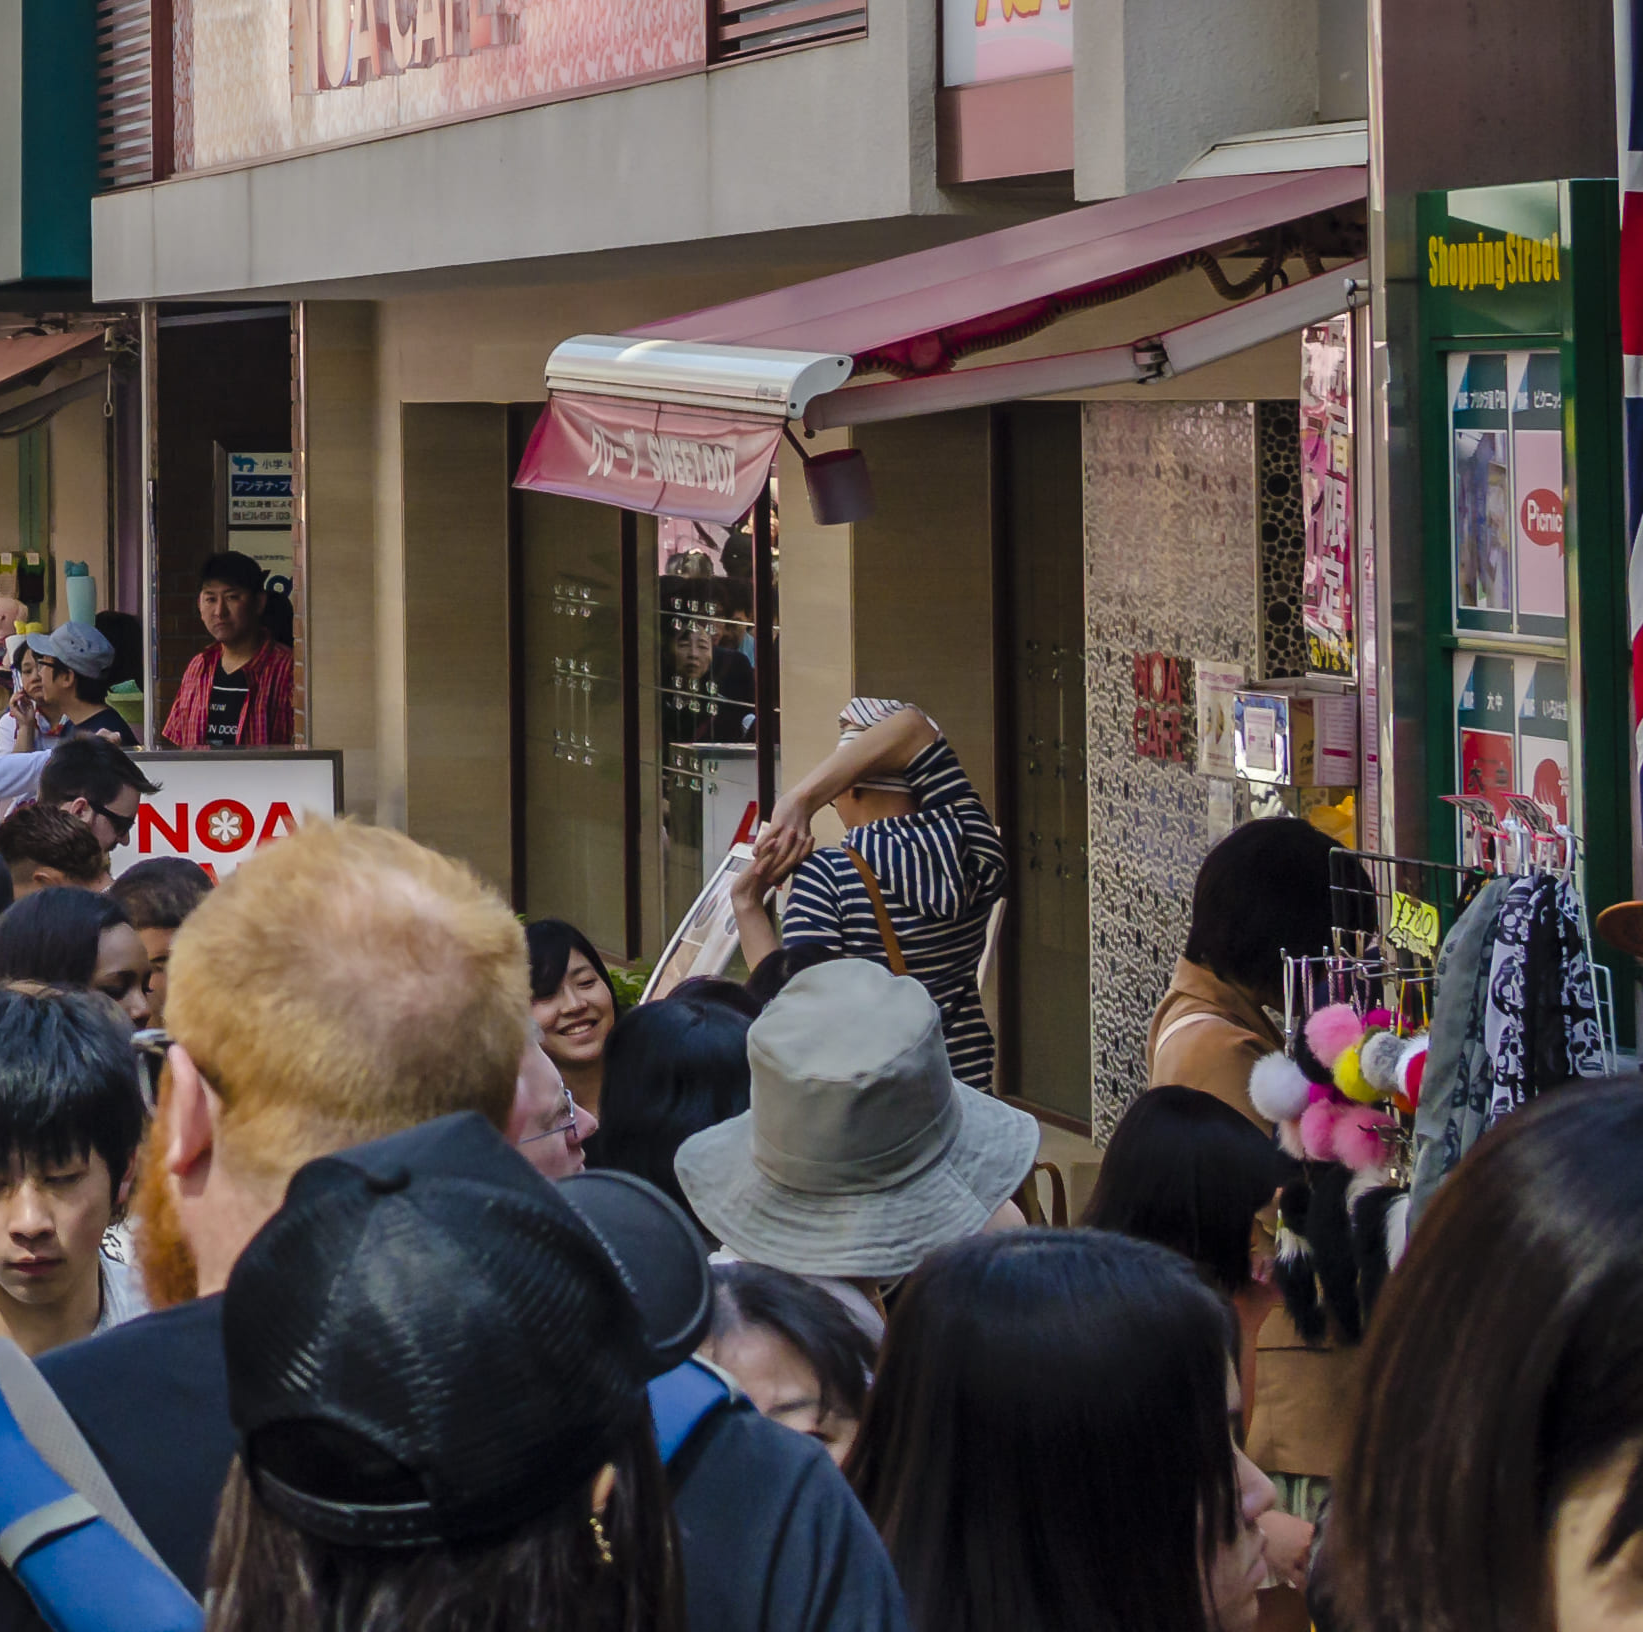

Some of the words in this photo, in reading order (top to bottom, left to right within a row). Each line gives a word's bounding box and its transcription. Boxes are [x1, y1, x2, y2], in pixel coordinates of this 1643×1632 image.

[1428, 231, 1505, 291] Shopping
[1506, 231, 1560, 285] Street
[646, 432, 702, 489] SWEET
[701, 443, 736, 497] BOX
[1527, 499, 1564, 533] Picnic
[1133, 651, 1182, 707] NOA
[1133, 706, 1183, 762] CAFE
[136, 798, 304, 856] NOA
